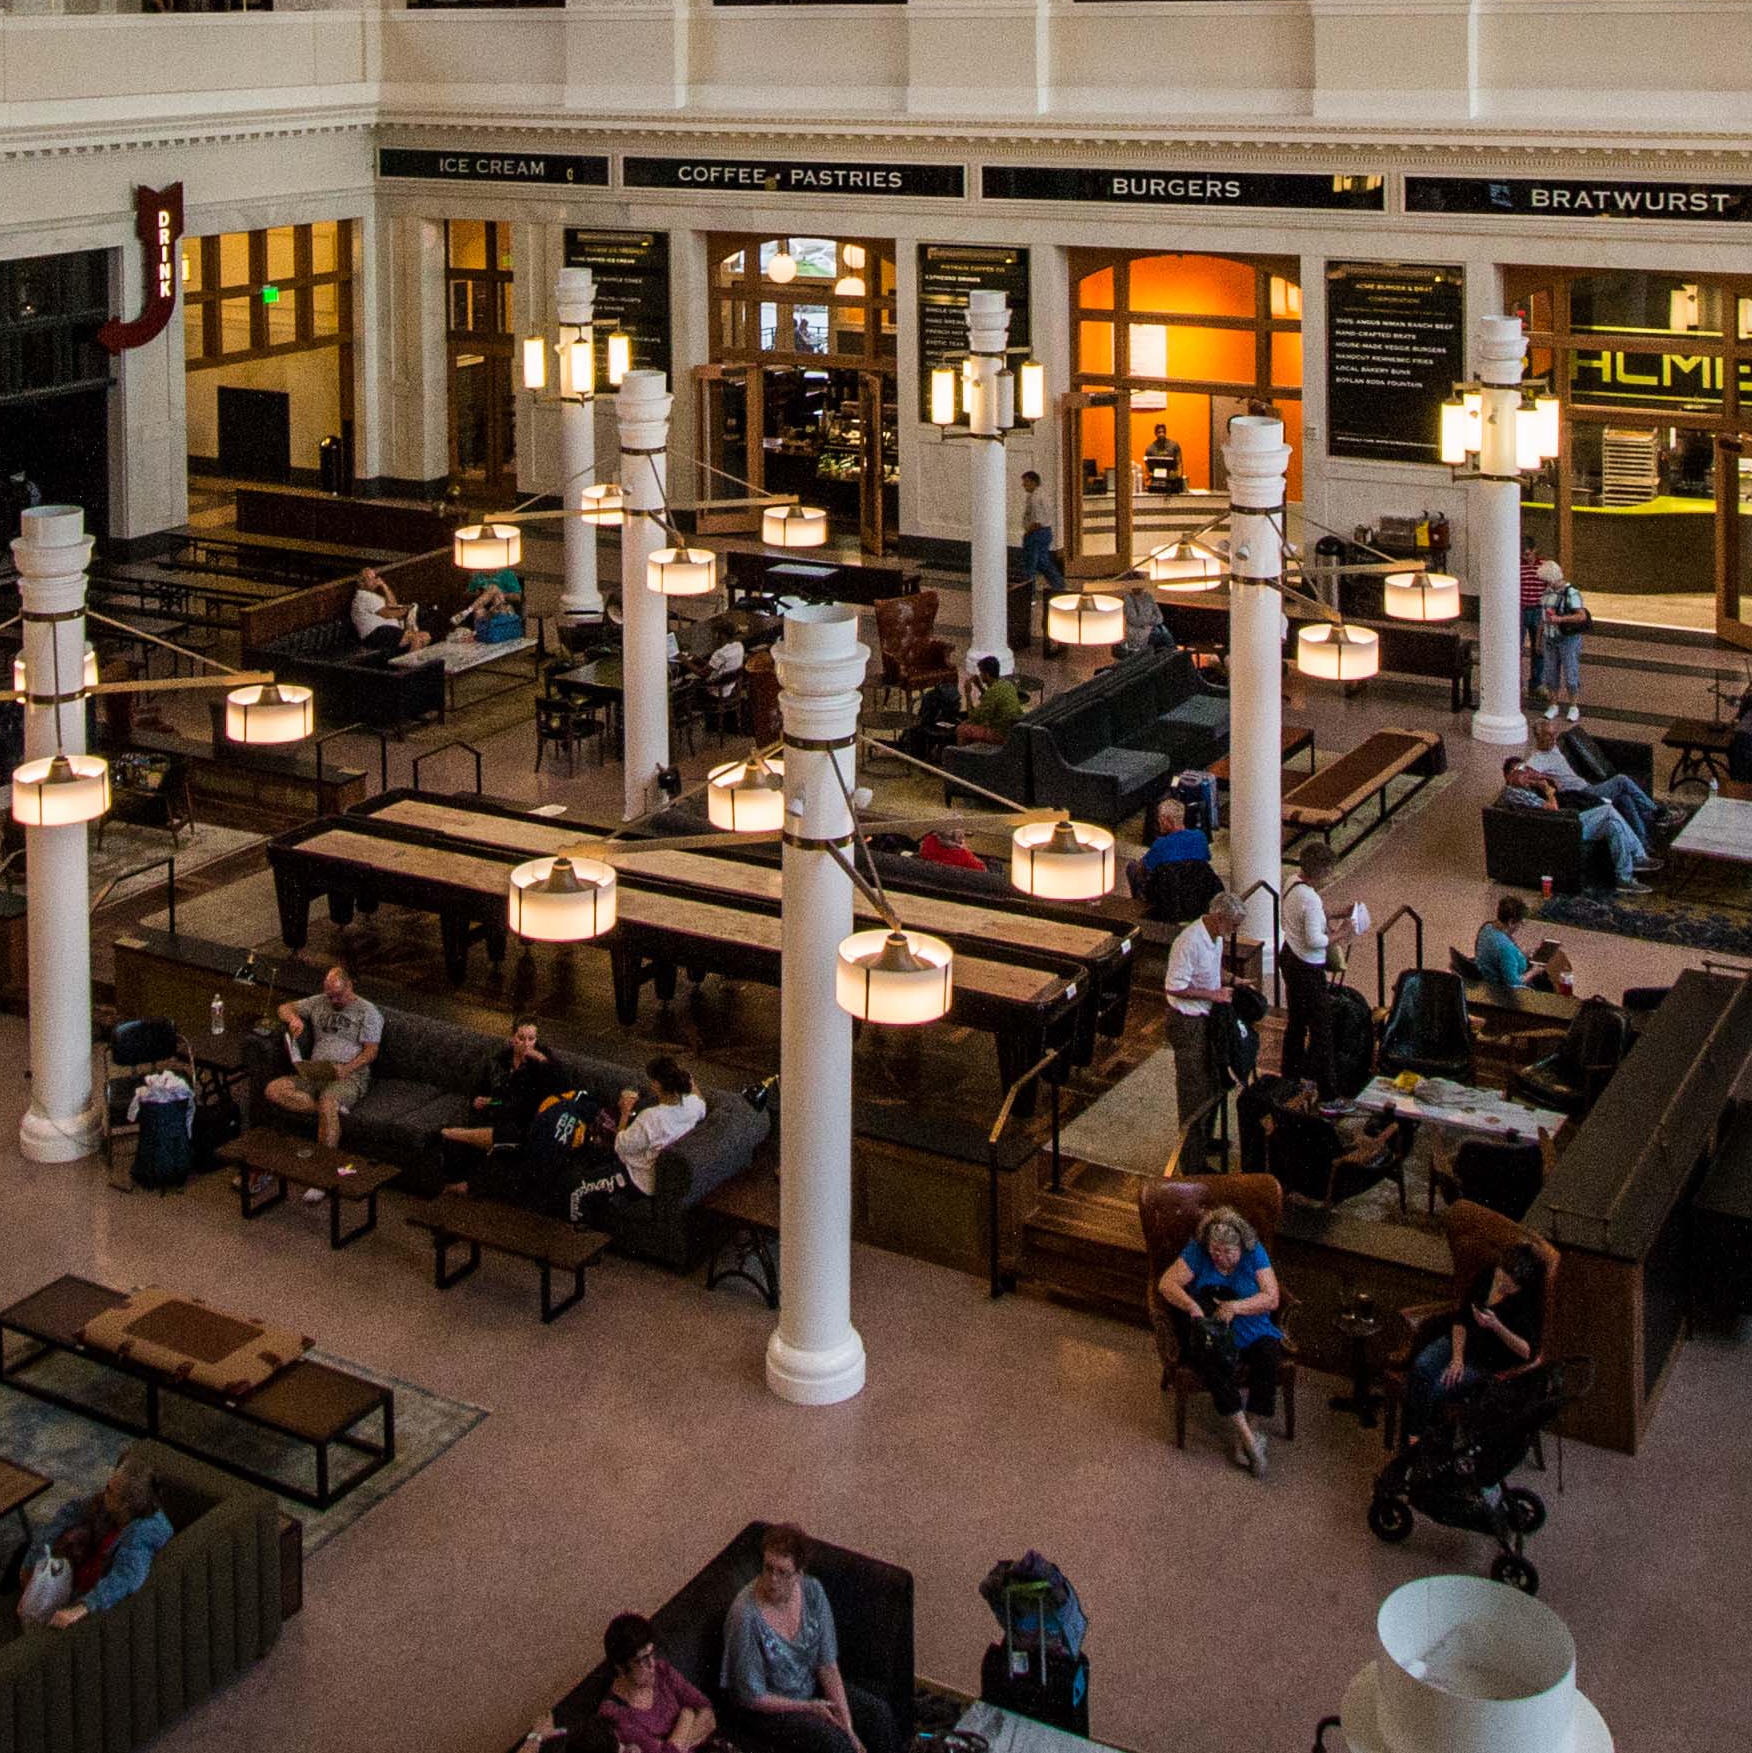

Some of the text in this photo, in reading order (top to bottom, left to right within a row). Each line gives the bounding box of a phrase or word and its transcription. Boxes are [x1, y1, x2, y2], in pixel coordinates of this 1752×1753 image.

[438, 157, 546, 177] ICE CREAM
[677, 165, 904, 189] COFFEE PASTRIES
[1112, 177, 1241, 198] BURGERS
[1530, 188, 1731, 213] BRATWURST
[157, 210, 172, 298] DRINK
